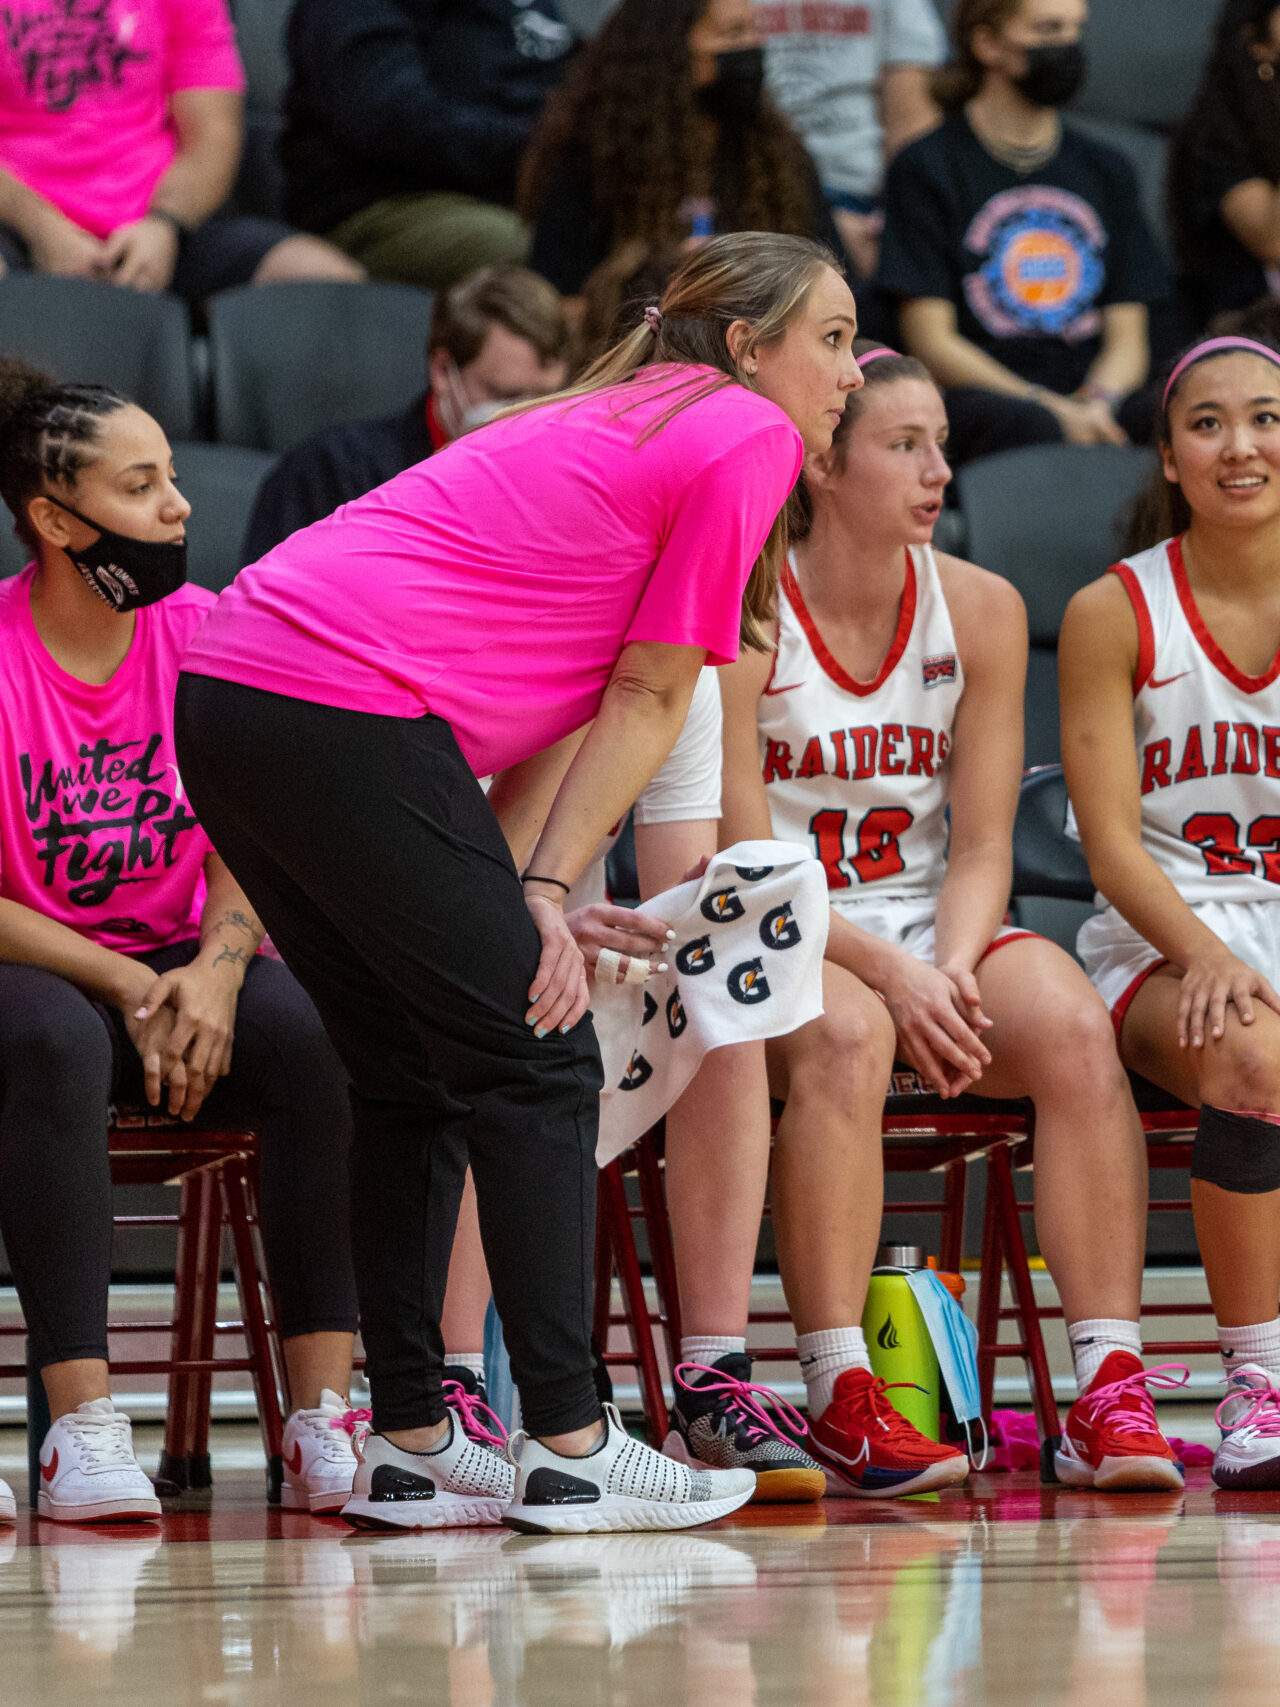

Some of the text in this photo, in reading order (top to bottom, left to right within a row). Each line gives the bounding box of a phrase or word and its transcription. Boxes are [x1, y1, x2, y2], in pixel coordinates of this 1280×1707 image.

[19, 733, 167, 823] United
[762, 723, 950, 785] RAIDERS
[32, 788, 201, 907] Fight
[759, 900, 803, 951] G
[726, 956, 772, 1005] G
